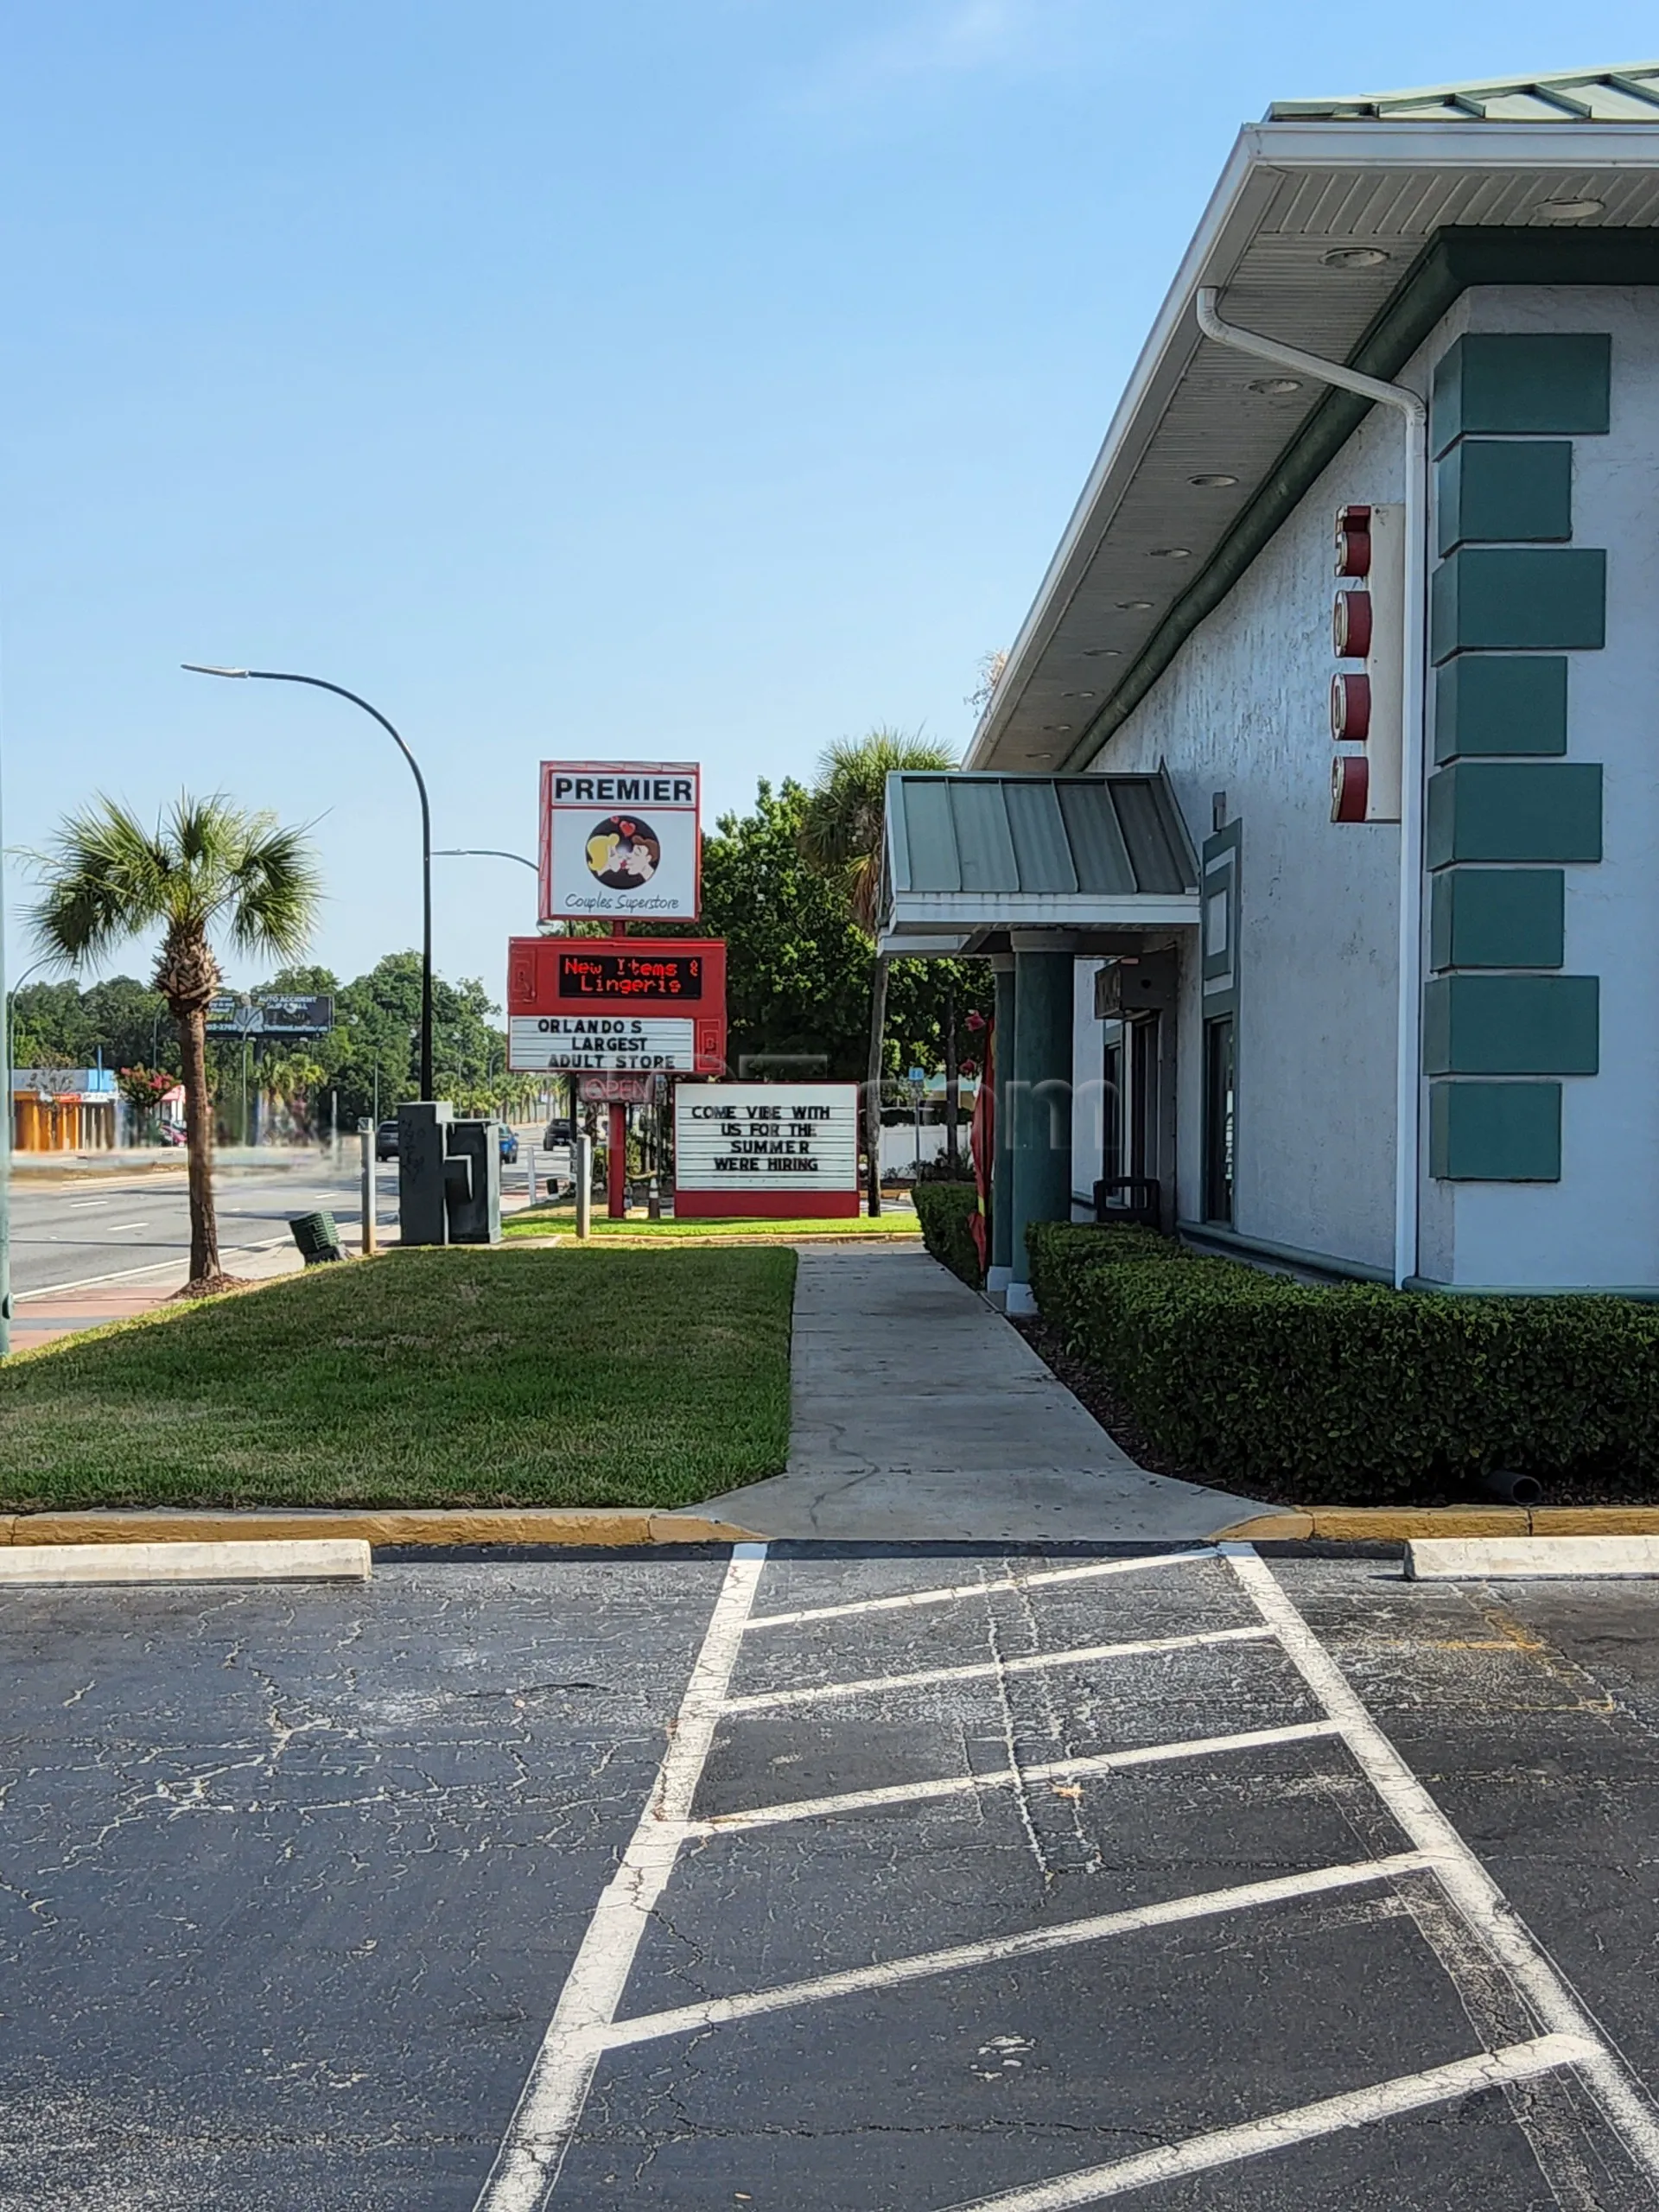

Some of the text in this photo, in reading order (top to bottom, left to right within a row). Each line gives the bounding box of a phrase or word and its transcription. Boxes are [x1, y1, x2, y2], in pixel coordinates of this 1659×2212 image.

[556, 778, 691, 801] PREMIER
[565, 891, 679, 912] Couples Superstore
[565, 958, 602, 975] New
[617, 958, 678, 976] Items
[572, 1037, 647, 1051] LARGEST
[548, 1053, 675, 1069] ADULT STORE
[585, 1077, 647, 1100] OPEN
[691, 1106, 830, 1120] COME VIBE WITH
[721, 1123, 741, 1136] US
[750, 1123, 779, 1136] FOR
[730, 1141, 810, 1154] SUMMER
[715, 1158, 818, 1171] WERE HIRING
